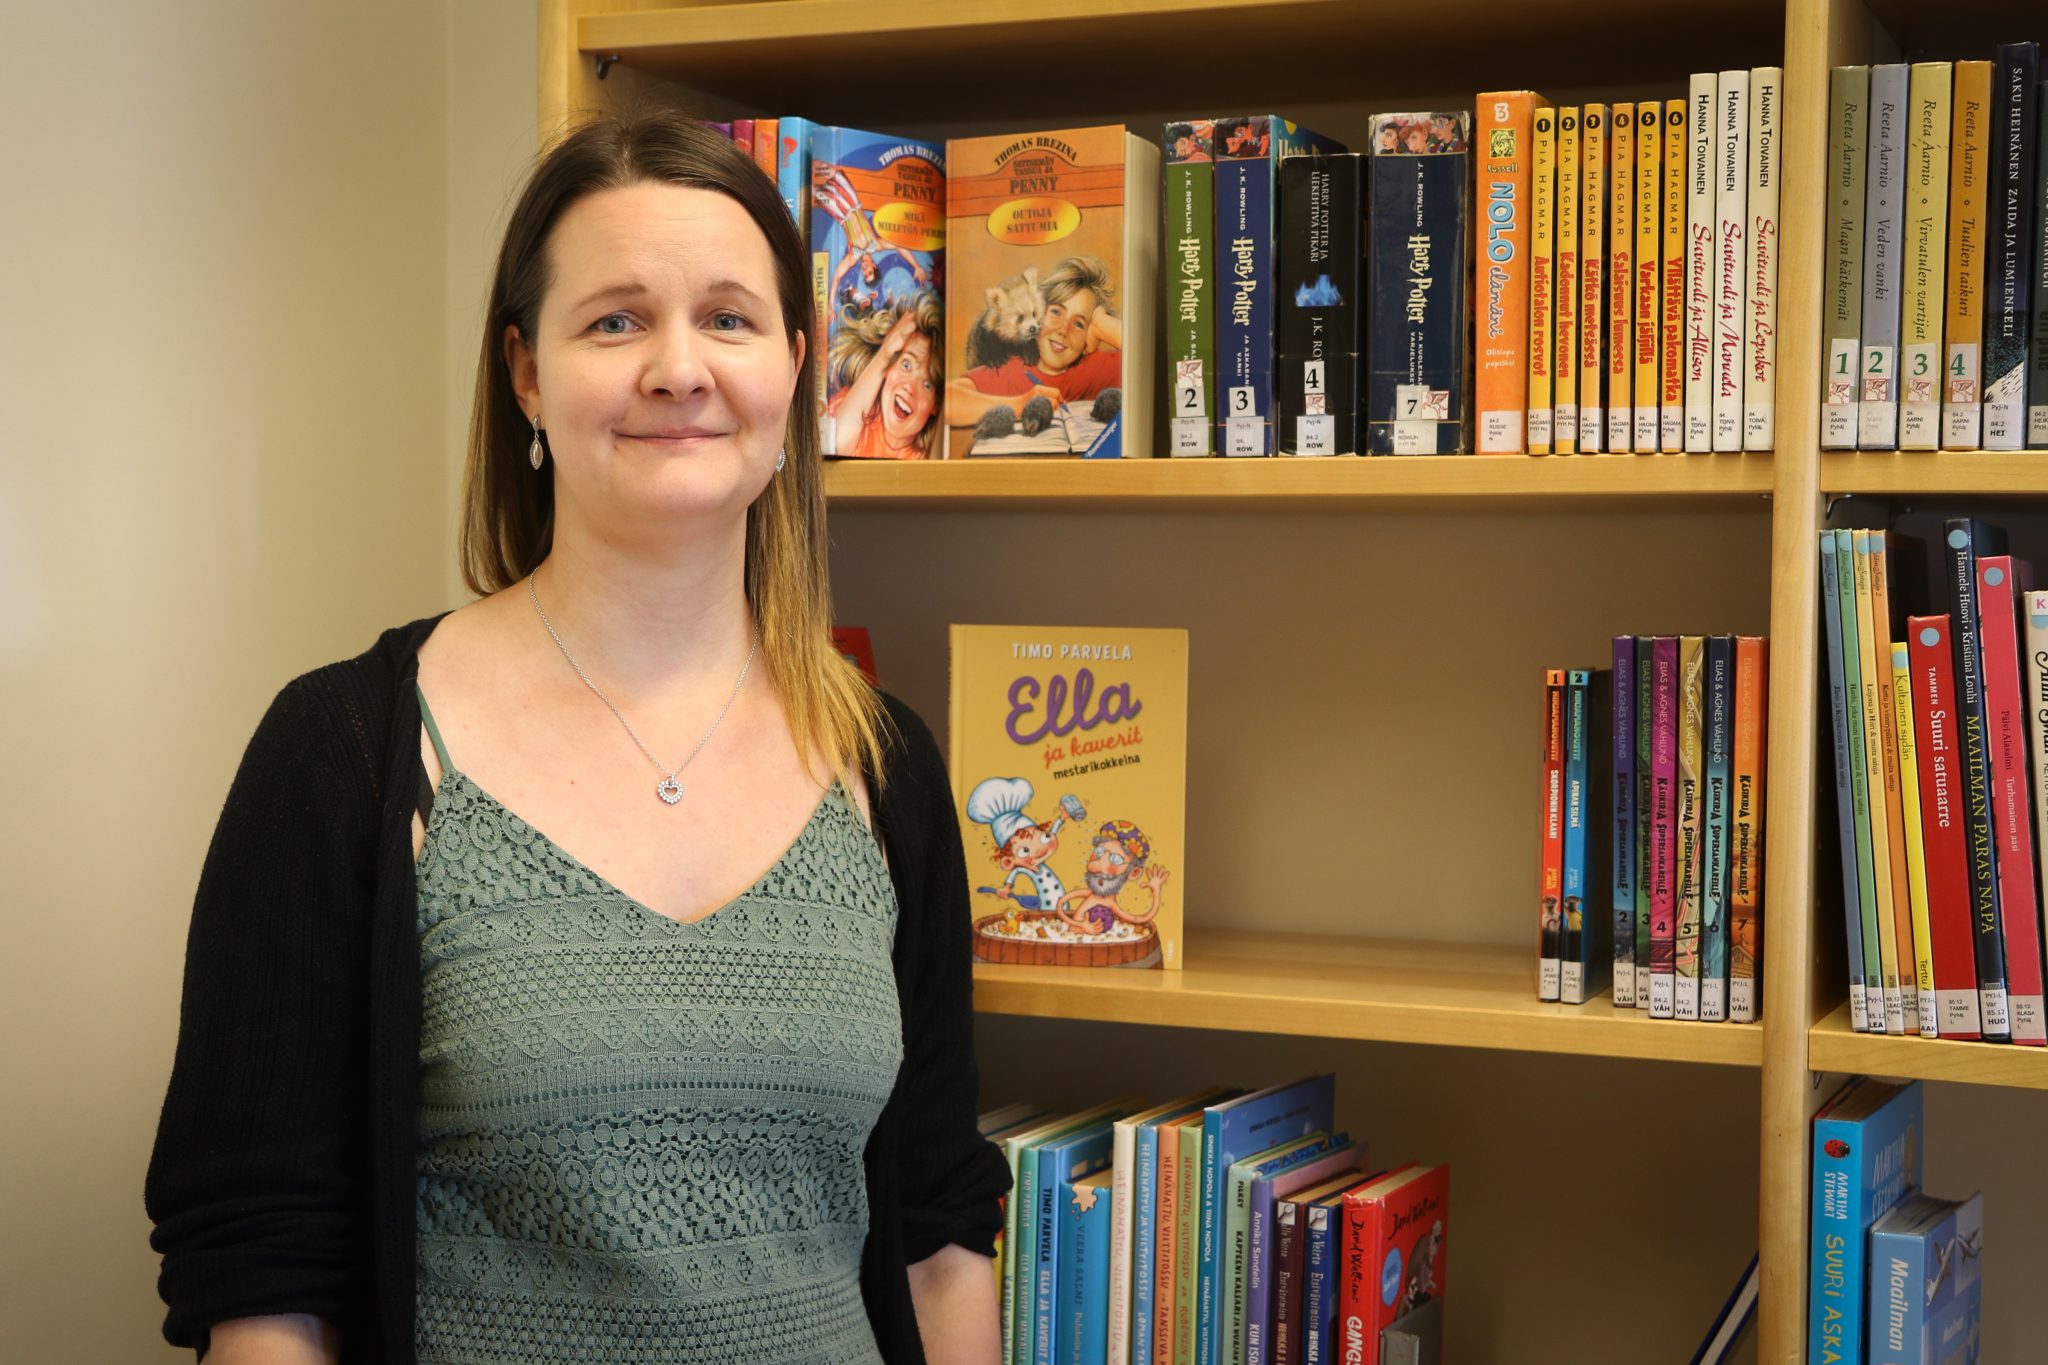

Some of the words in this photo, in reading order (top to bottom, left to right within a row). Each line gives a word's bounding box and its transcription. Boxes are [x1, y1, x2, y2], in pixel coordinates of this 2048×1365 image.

[2010, 67, 2022, 102] SAKU
[1696, 94, 1709, 135] HANNA
[1727, 90, 1740, 130] HANNA
[1760, 86, 1774, 126] HANNA
[1843, 102, 1857, 138] Reeta
[1881, 102, 1894, 138] Reeta
[1923, 100, 1936, 136] Reeta
[1966, 100, 1979, 138] Reeta
[994, 138, 1034, 167] THOMAS
[1036, 137, 1078, 162] BREZINA
[1538, 140, 1548, 165] PIA
[1563, 138, 1572, 164] PIA
[1588, 136, 1597, 162] PIA
[1617, 135, 1626, 161] PIA
[1644, 134, 1652, 159] PIA
[1671, 134, 1680, 159] PIA
[1726, 134, 1738, 192] TOIVAINEN
[1759, 128, 1772, 188] TOIVAINEN
[1921, 141, 1935, 185] Aarnio
[1964, 142, 1977, 187] Aarnio
[2009, 108, 2021, 180] HEINÄNEN
[1010, 176, 1058, 194] PENNY
[1696, 137, 1708, 195] TOIVAINEN
[1843, 143, 1855, 188] Aarnio
[1880, 144, 1893, 188] Aarnio
[894, 182, 937, 202] PENNY
[1320, 174, 1329, 203] HARRY
[1538, 175, 1547, 240] HAGMAR
[1562, 173, 1572, 238] HAGMAR
[1588, 171, 1597, 236] HAGMAR
[1616, 170, 1626, 236] HAGMAR
[1642, 169, 1652, 234] HAGMAR
[1670, 168, 1679, 234] HAGMAR
[2007, 189, 2018, 229] ZAIDA
[1006, 220, 1058, 233] SATTUMIA
[1012, 208, 1052, 220] OUTOJA
[1320, 205, 1329, 242] POTTER
[1487, 182, 1516, 262] NOLO
[1178, 238, 1201, 279] Harry
[1232, 238, 1254, 279] Harry
[1310, 230, 1319, 263] PIKARI
[1408, 235, 1431, 278] Harry
[1877, 219, 1890, 258] Veden
[1918, 217, 1932, 285] Virvatulen
[1960, 218, 1975, 267] Tuulien
[2005, 233, 2016, 247] JA
[1180, 278, 1203, 323] Potter
[1232, 278, 1256, 326] Potter
[1408, 276, 1432, 324] Potter
[1489, 266, 1510, 339] elämäni
[1533, 256, 1549, 327] Autiotalon
[1559, 251, 1575, 318] Kadonnut
[1613, 252, 1628, 316] Salaisuus
[1640, 261, 1655, 319] Varkaan
[1667, 257, 1682, 321] Yllättävä
[1838, 260, 1852, 321] kätkemät
[1876, 263, 1889, 301] vanki
[1959, 272, 1973, 317] taikuri
[2003, 252, 2016, 337] LUMIENKELI
[1688, 306, 1706, 322] ja
[1718, 303, 1736, 320] ja
[1751, 300, 1769, 316] ja
[1913, 290, 1929, 339] vartijat
[1532, 330, 1547, 376] rosvot
[1559, 321, 1573, 377] hevonen
[1585, 304, 1597, 368] metsässä
[1613, 320, 1628, 374] lumessa
[1637, 322, 1655, 364] jäljillä
[1689, 323, 1710, 381] Allison
[1750, 319, 1772, 382] Lepakot
[1306, 368, 1319, 388] 4
[1664, 325, 1681, 401] pakomatka
[1719, 321, 1740, 397] Manuela
[1836, 353, 1849, 374] 1
[1868, 351, 1883, 374] 2
[1913, 353, 1928, 376] 3
[1950, 353, 1965, 376] 4
[1184, 388, 1198, 408] 2
[1236, 390, 1248, 410] 3
[1407, 400, 1418, 414] 7
[1957, 551, 1968, 591] Hannele
[1960, 594, 1972, 623] Huovi
[1012, 642, 1054, 660] TIMO
[1060, 644, 1132, 661] PARVELA
[1660, 661, 1668, 683] ELIAS
[1715, 660, 1723, 681] ELIAS
[1962, 632, 1974, 672] Kristiina
[1895, 675, 1908, 727] Kultainen
[1929, 667, 1938, 704] TAMMEN
[1965, 675, 1977, 703] Louhi
[1005, 668, 1142, 745] Ella
[1659, 694, 1667, 722] AGNES
[2001, 710, 2011, 730] Päivi
[1044, 745, 1066, 770] ja
[1070, 726, 1143, 757] kaverit
[1901, 730, 1913, 760] sydän
[1930, 710, 1948, 751] Suuri
[1053, 753, 1141, 781] mestarikokkeina
[1967, 715, 1986, 817] MAAILMAN
[2002, 734, 2013, 770] Alasalmi
[1656, 778, 1668, 820] KÄSIKIRJA
[1711, 777, 1722, 819] KÄSIKIRJA
[1739, 775, 1751, 817] KÄSIKIRJA
[1933, 756, 1950, 827] satuaarre
[2006, 777, 2019, 833] Turhamainen
[1656, 824, 1667, 894] SUPERSANKAREILLE
[1682, 827, 1694, 899] SUPERSANKAREILLE
[1709, 825, 1722, 897] SUPERSANKAREILLE
[1738, 823, 1750, 895] SUPERSANKAREILLE
[1974, 823, 1991, 879] PARAS
[1656, 921, 1666, 932] 4
[1682, 922, 1692, 934] 5
[1738, 920, 1748, 931] 7
[1979, 886, 1995, 934] NAPA
[1919, 960, 1928, 986] Terttu
[1654, 1004, 1670, 1012] VÅH
[1676, 1008, 1692, 1016] VÅH
[1703, 1009, 1719, 1017] VÅH
[1732, 1004, 1748, 1012] VÅH
[1042, 1188, 1052, 1213] TIMO
[1824, 1172, 1835, 1218] STEWART
[1836, 1172, 1848, 1219] MARTHA
[1041, 1218, 1051, 1262] PARVELA
[1204, 1231, 1212, 1262] NOPOLA
[1253, 1211, 1262, 1244] Annika
[1160, 1226, 1171, 1288] VILTTITOSSU
[1235, 1231, 1243, 1275] KAPTEENI
[1251, 1247, 1261, 1288] Sandelin
[1311, 1242, 1324, 1264] Veirto
[1040, 1270, 1050, 1294] ELLA
[1040, 1299, 1050, 1310] JA
[1889, 1258, 1908, 1351] Maailman
[1039, 1316, 1049, 1357] KAVERIT
[1159, 1307, 1168, 1355] TANSSIVA
[1250, 1324, 1259, 1344] KUN
